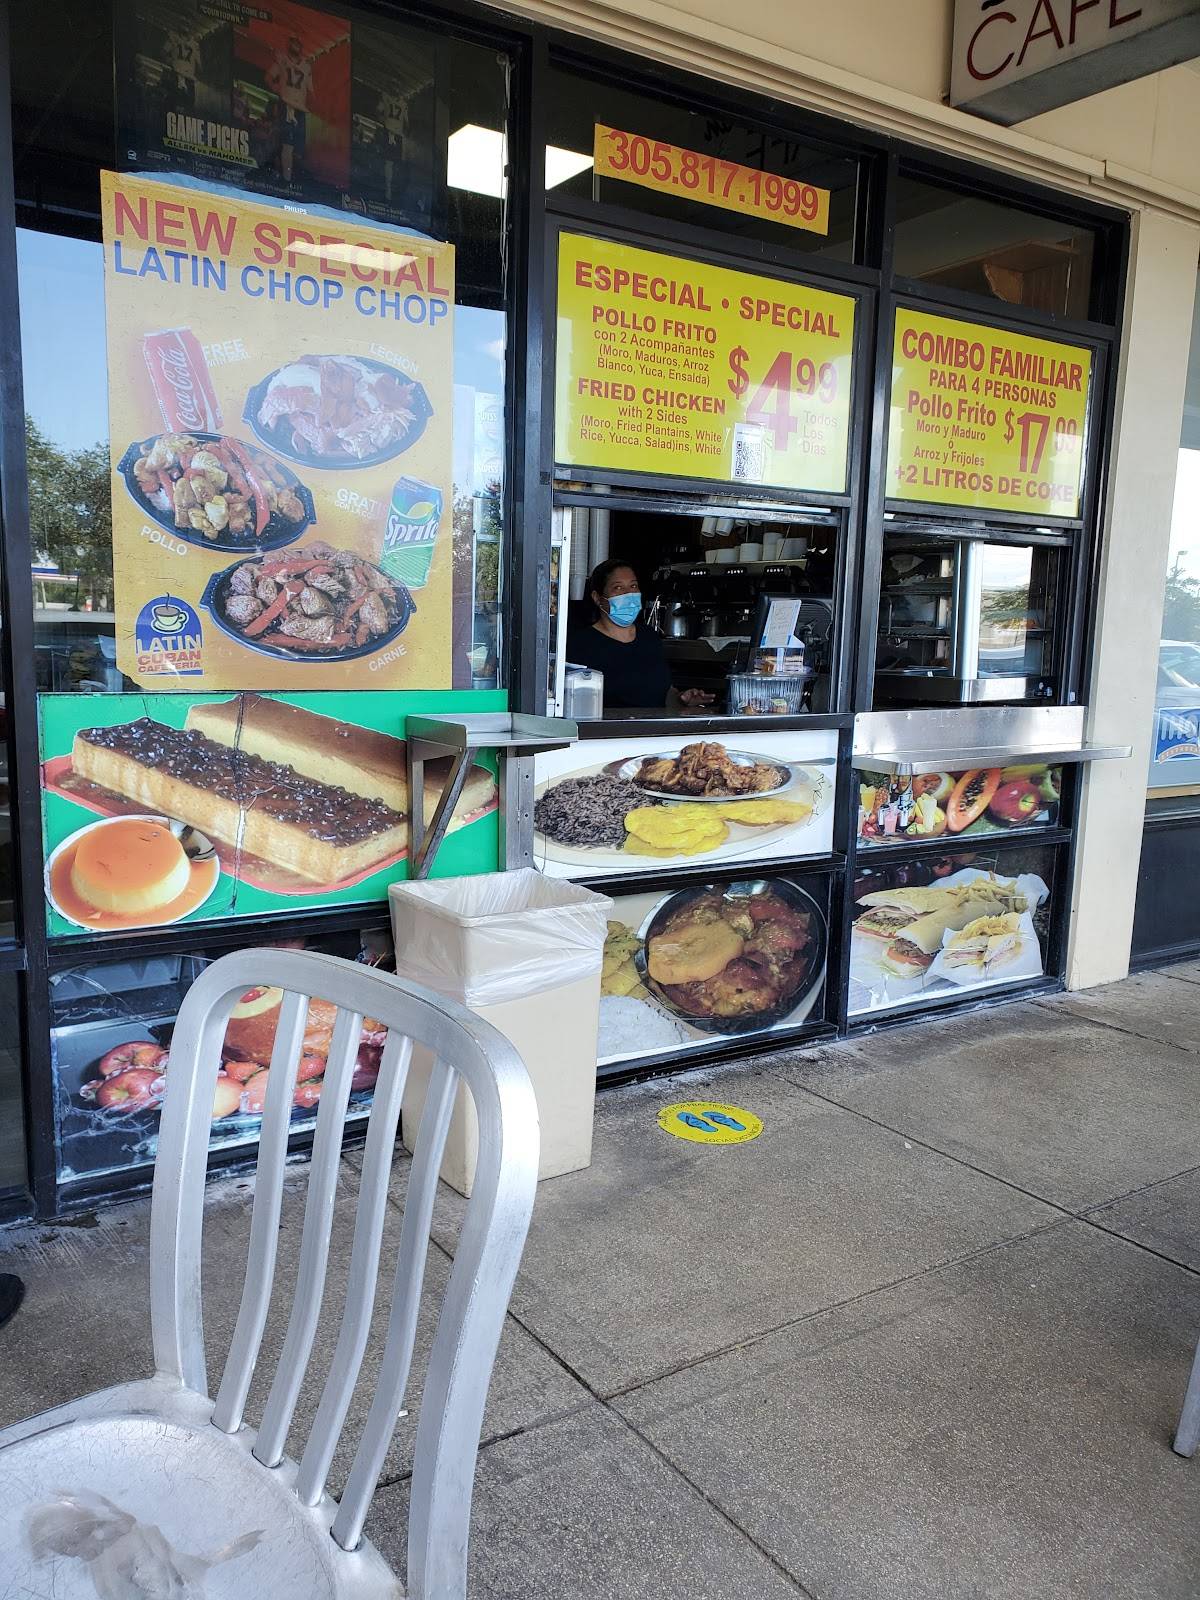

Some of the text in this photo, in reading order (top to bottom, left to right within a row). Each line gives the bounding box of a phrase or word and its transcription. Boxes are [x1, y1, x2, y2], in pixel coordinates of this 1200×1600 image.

[166, 111, 250, 157] GAME PICKS
[167, 140, 195, 151] ALLEN
[607, 130, 819, 221] 305.817.1999
[283, 204, 309, 215] PHILIPS
[114, 191, 450, 297] NEW SPECIAL
[114, 240, 449, 326] LATIN CHOP CHOP
[575, 260, 840, 339] ESPECIAL SPECIAL
[592, 305, 717, 344] POLLO FRITO
[203, 338, 246, 361] FREE
[594, 330, 715, 359] con 2 Acompañantes
[599, 343, 709, 372] (Moro, Maduros, Arroz
[597, 357, 710, 388] Blanco, Yuca, Ensalda)
[902, 328, 1083, 392] COMBO FAMILIAR
[578, 377, 726, 415] FRIED CHICKEN
[929, 368, 1056, 409] PARA 4 PERSONAS
[618, 404, 688, 424] with 2 Sides
[803, 410, 838, 427] Todos
[908, 390, 996, 427] Pollo Frito
[580, 414, 722, 442] (Moro, Fried Plantains, White
[580, 428, 606, 443] Rice,
[608, 432, 642, 447] Yucca,
[695, 443, 722, 456] White
[803, 424, 825, 440] Los
[916, 419, 986, 441] Moro y Maduro
[913, 445, 985, 467] Arroz y Frijoles
[895, 464, 1074, 502] +2 LITROS DE COKE
[141, 525, 187, 556] POLLO
[384, 515, 439, 547] Sprite
[137, 634, 202, 656] LATIN
[137, 650, 201, 665] CUBAN
[368, 644, 408, 672] CARNE
[137, 661, 201, 673] CAFEERIA
